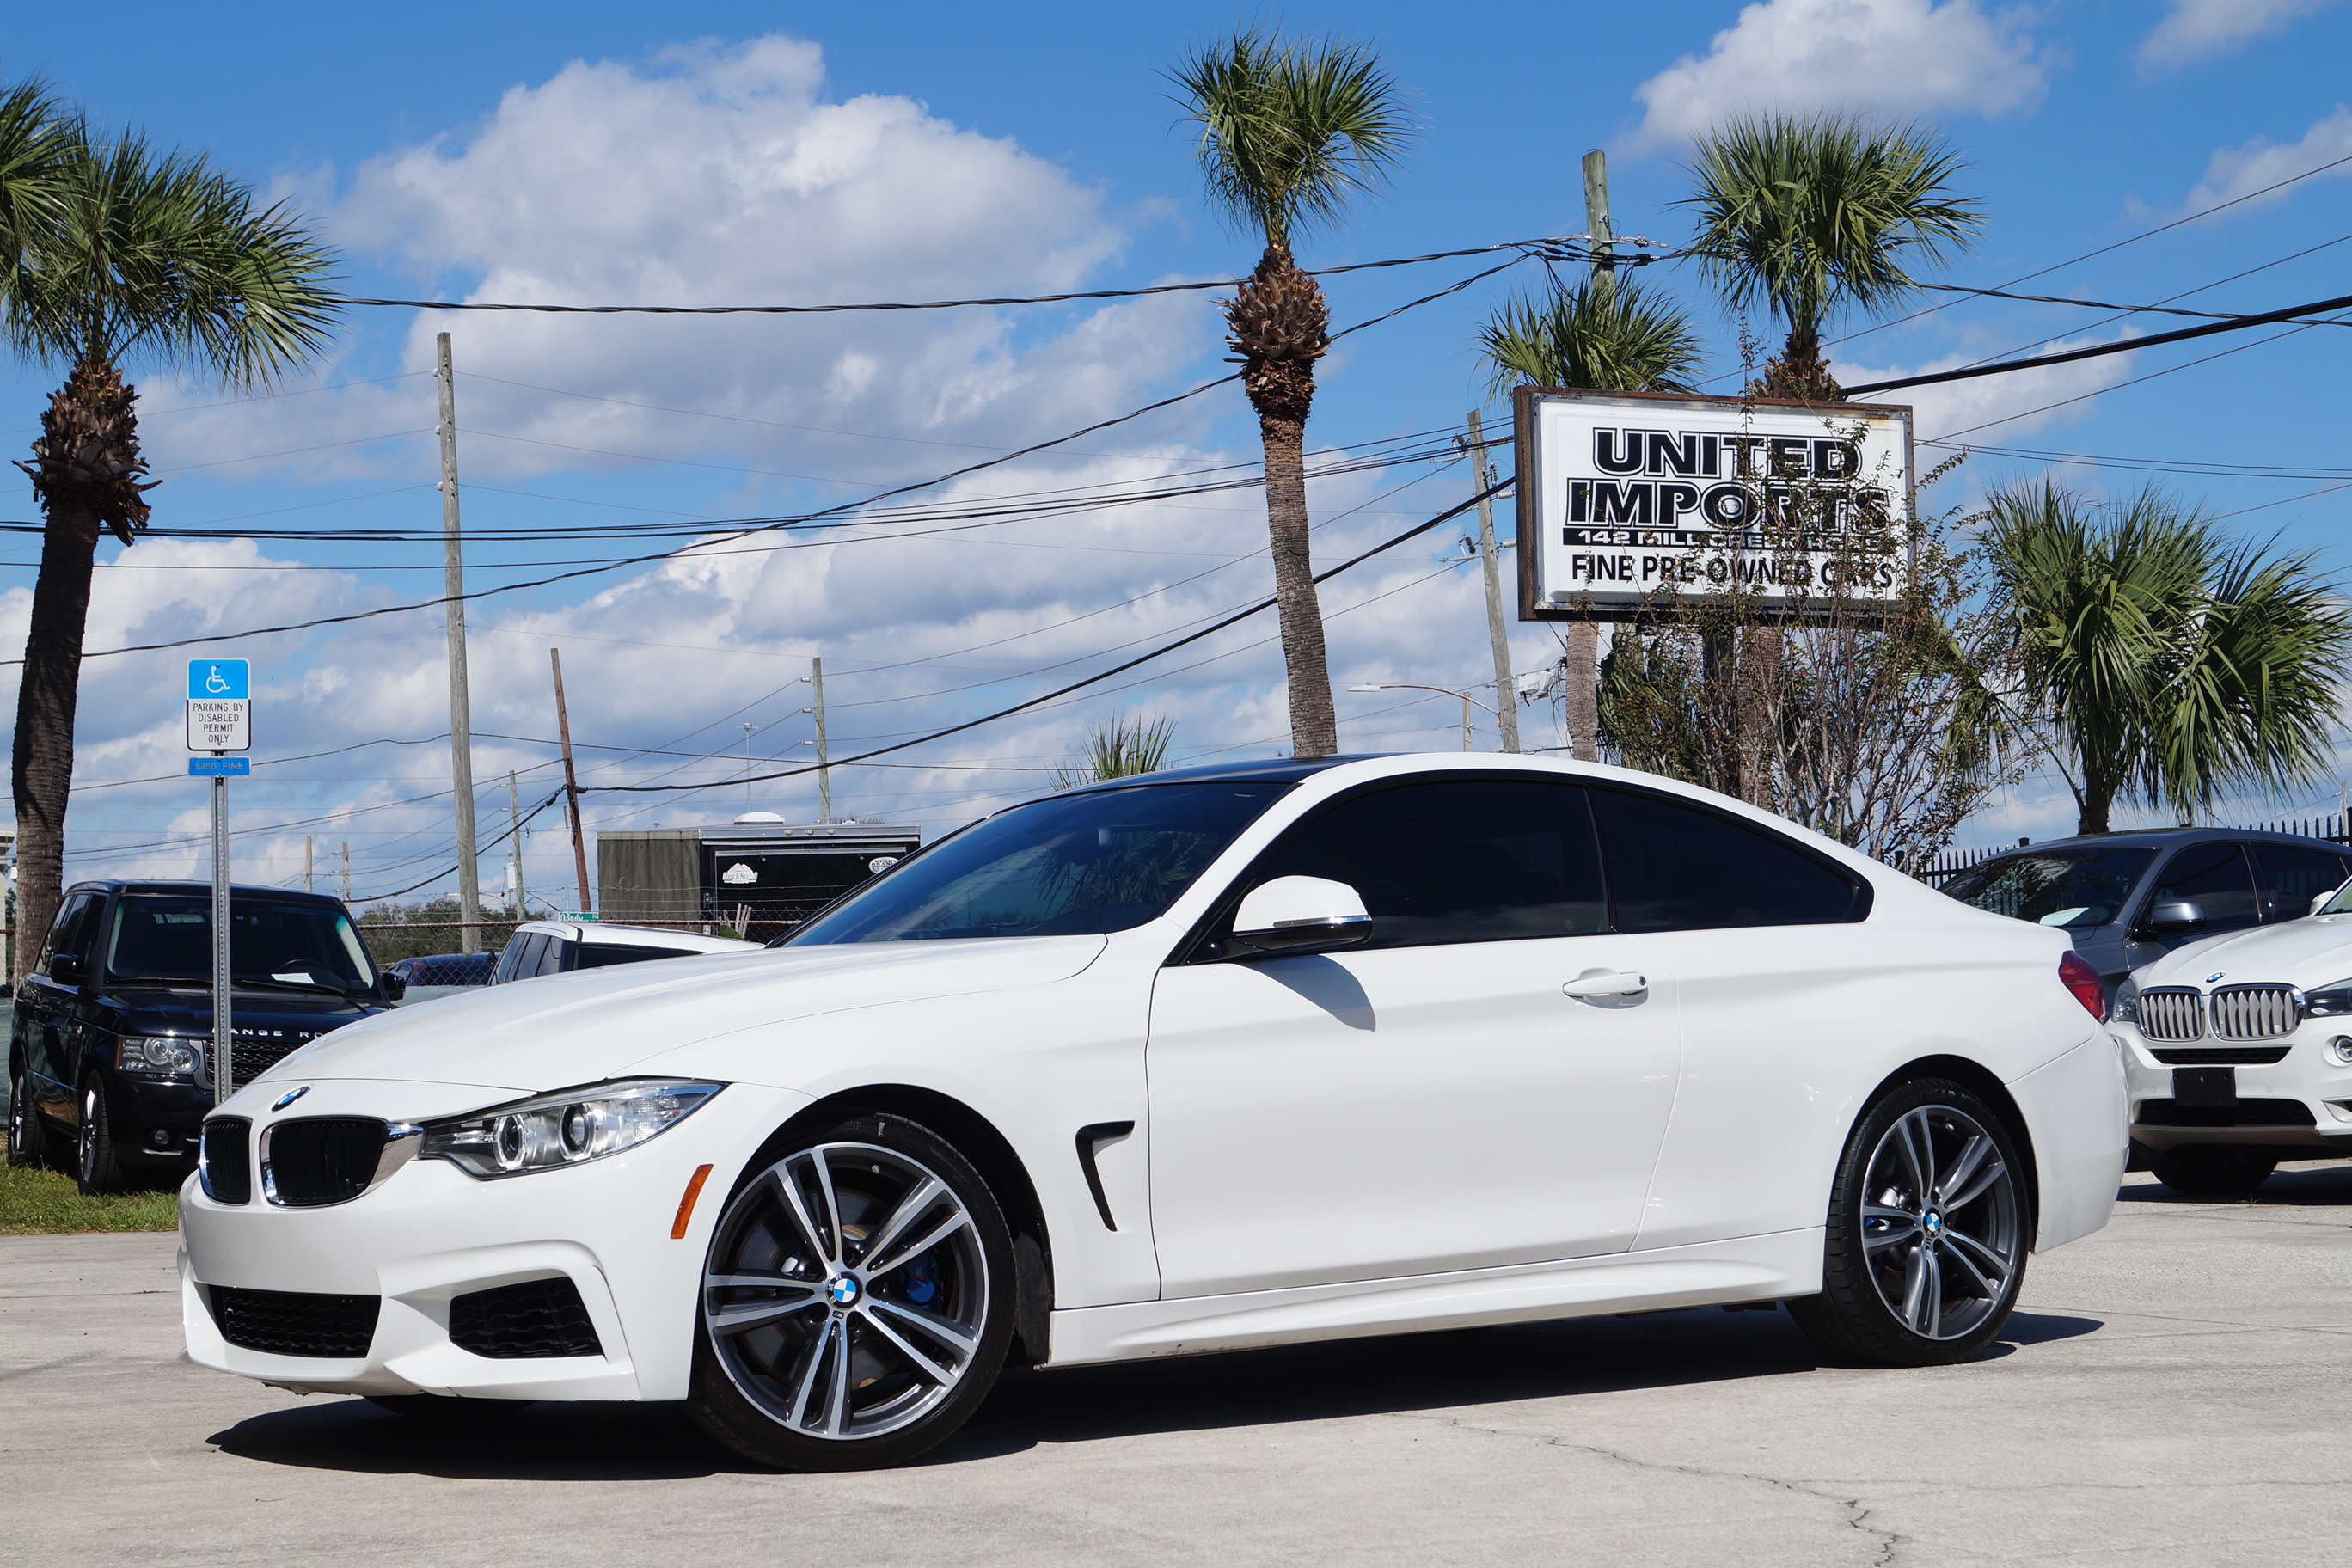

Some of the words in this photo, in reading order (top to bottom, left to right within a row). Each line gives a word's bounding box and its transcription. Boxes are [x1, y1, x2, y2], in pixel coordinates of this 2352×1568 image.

[1593, 427, 1863, 481] UNITED
[1565, 477, 1891, 536] IMPORTS
[1578, 530, 1631, 544] 142
[1638, 531, 1700, 547] MILL
[1572, 554, 1633, 581] FINE
[1821, 560, 1892, 588] CRS
[193, 702, 229, 712] PARKING
[233, 702, 243, 711] BY
[198, 714, 239, 722] DISABLED
[203, 724, 234, 732] PERMIT
[208, 734, 229, 744] ONLY
[222, 762, 244, 770] FINE
